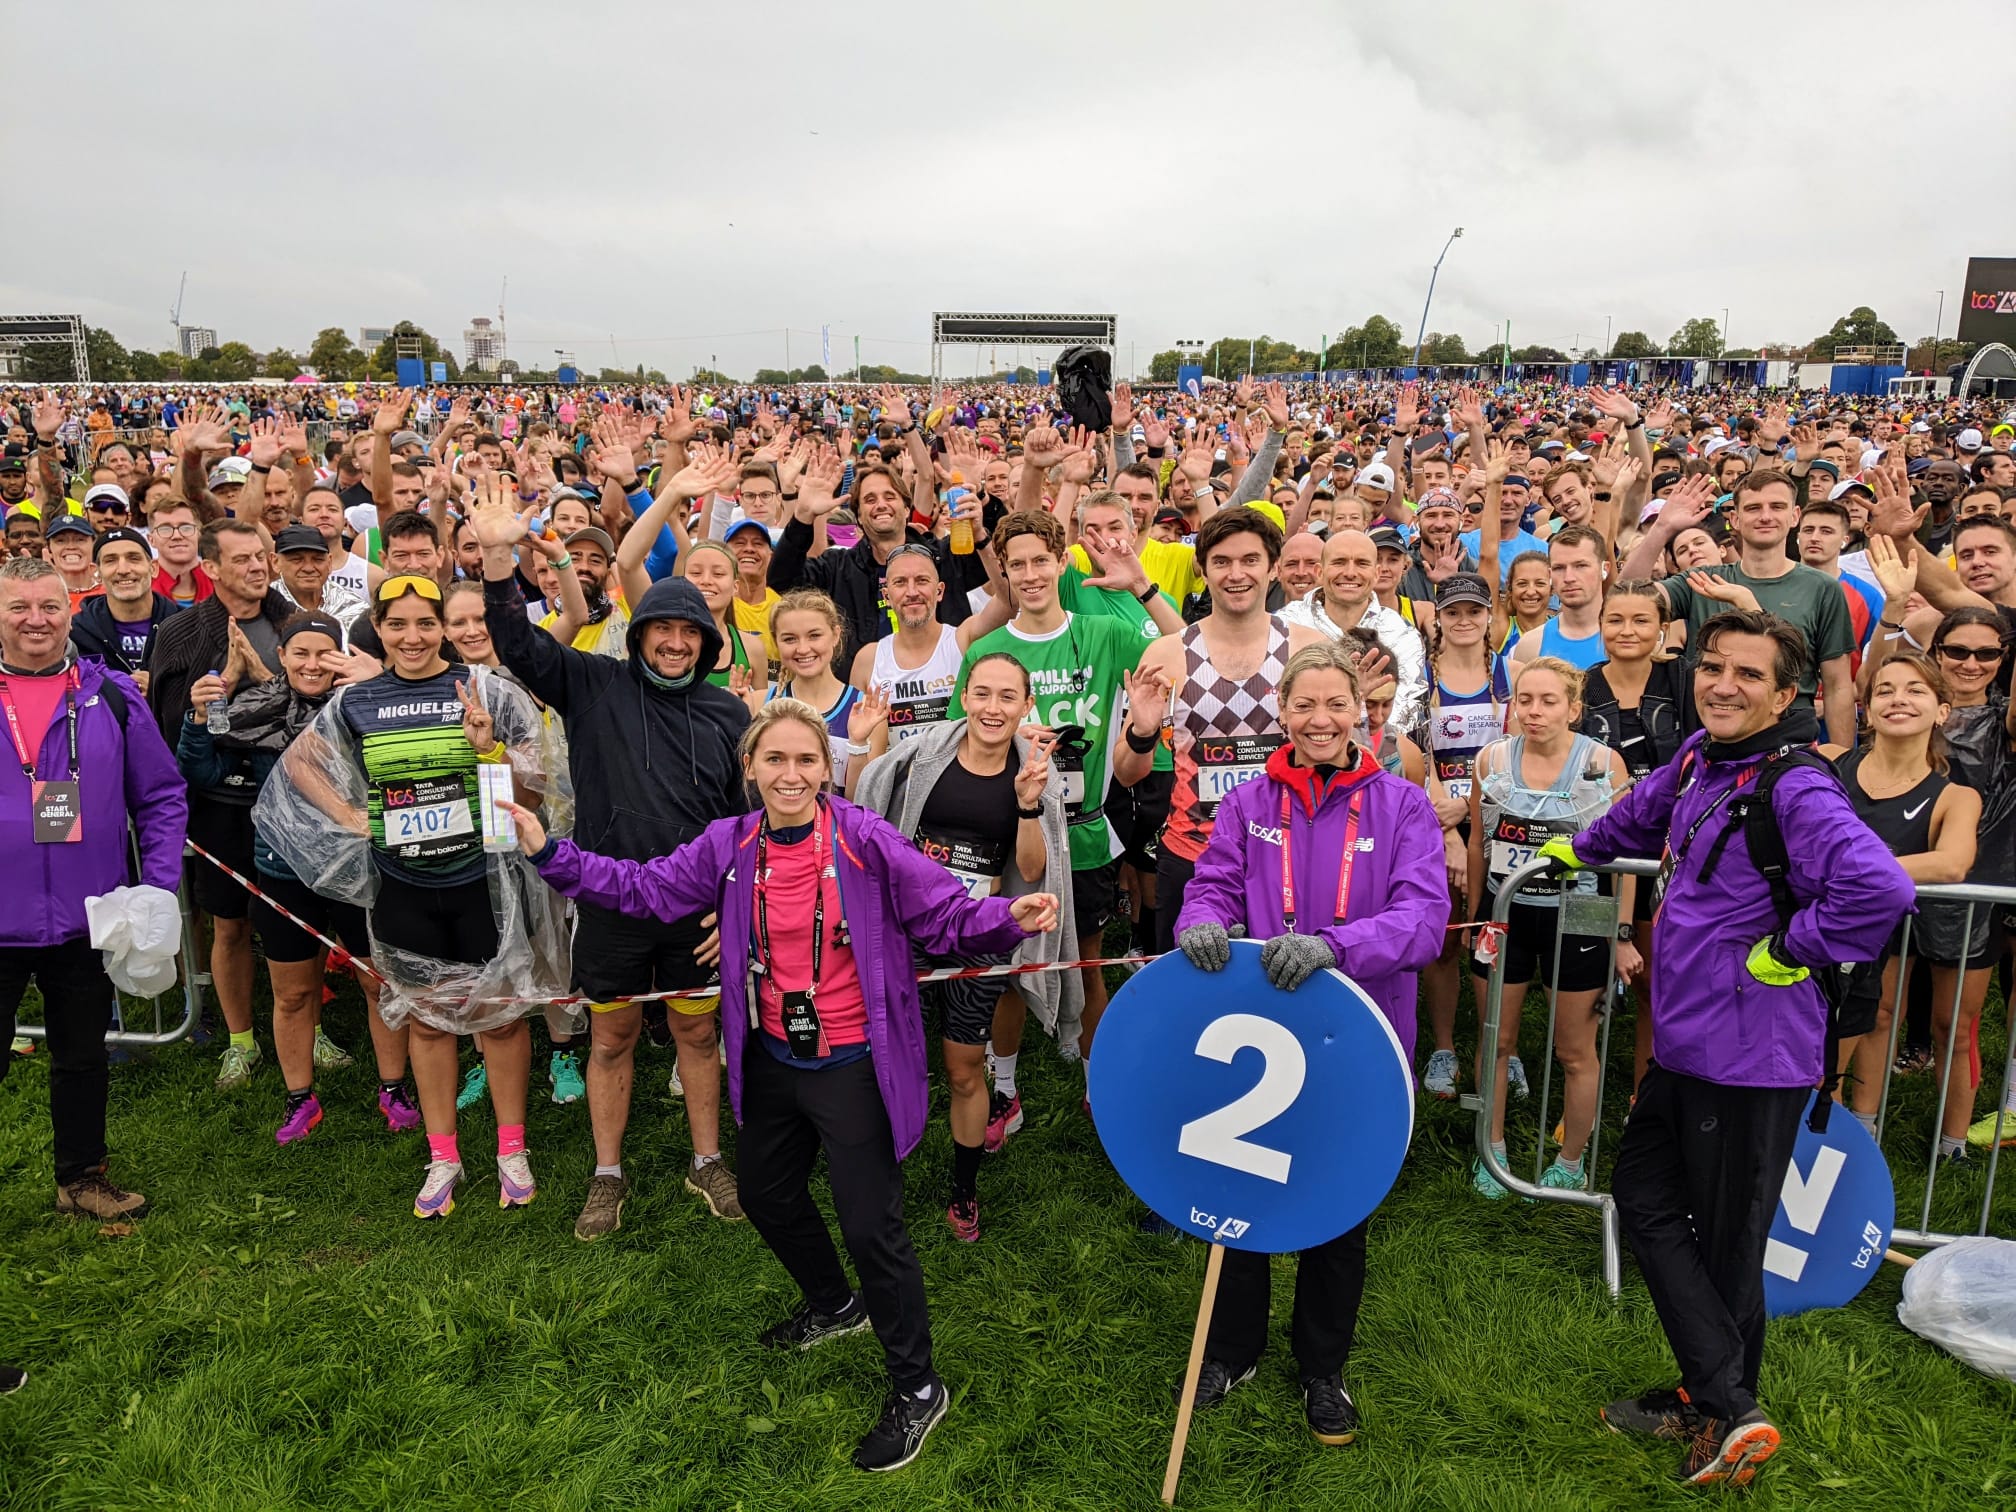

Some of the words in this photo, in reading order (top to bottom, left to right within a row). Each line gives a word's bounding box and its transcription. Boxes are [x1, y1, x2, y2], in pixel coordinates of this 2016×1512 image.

[1971, 290, 1997, 309] tcs
[378, 702, 464, 719] MIGUELES
[441, 712, 462, 722] TEAM
[1468, 721, 1502, 729] RESEARCH
[1203, 743, 1234, 762] tcs
[1237, 746, 1279, 754] CONSULTANCY
[1440, 762, 1465, 777] tcs
[386, 788, 415, 806] tcs
[416, 783, 459, 796] CONSULTANCY
[417, 793, 446, 802] SERVICES
[399, 807, 451, 836] 2107
[1249, 820, 1269, 839] tcs
[1529, 824, 1548, 832] TATA
[1498, 819, 1527, 842] tcs
[421, 849, 436, 857] new
[437, 843, 469, 854] balance
[923, 838, 950, 862] tcs
[954, 844, 972, 854] TATA
[951, 858, 978, 869] SERVICES
[1507, 847, 1538, 869] 27
[789, 1024, 817, 1032] GENERAL
[1178, 1013, 1307, 1185] 2
[1190, 1206, 1217, 1229] tcs
[1851, 1246, 1873, 1269] tcs
